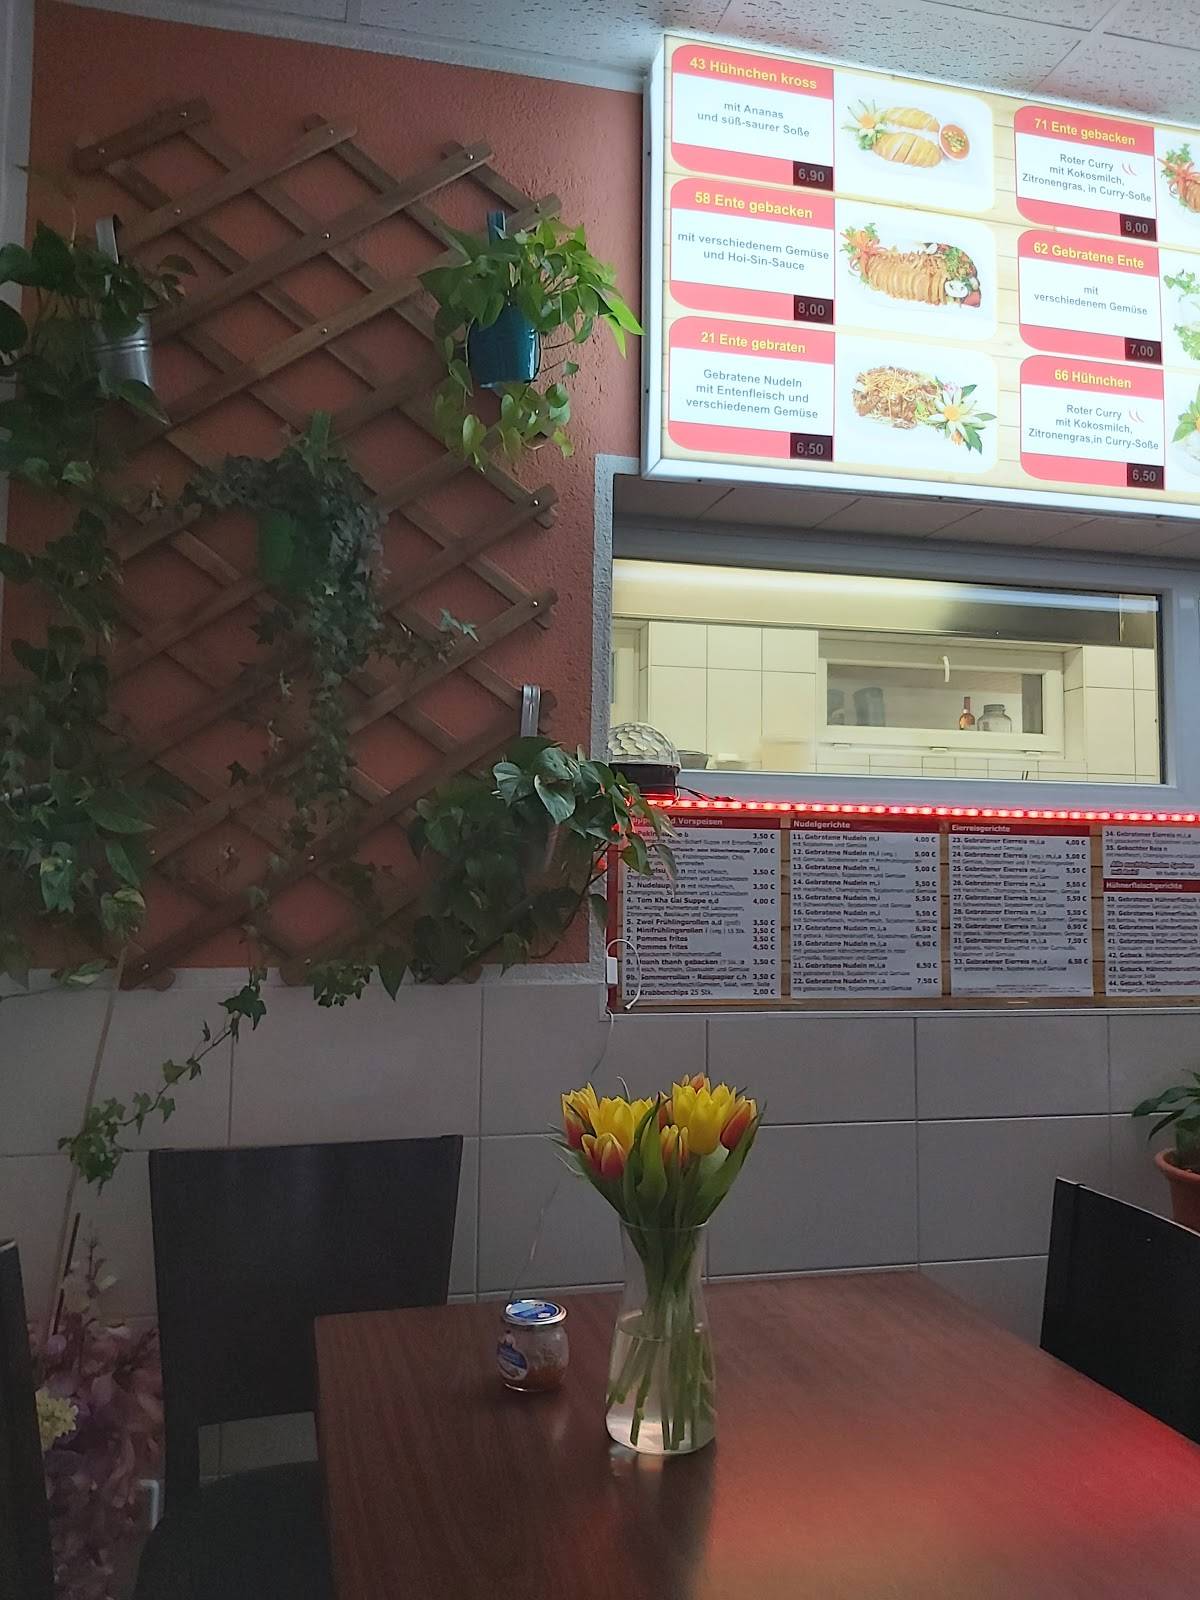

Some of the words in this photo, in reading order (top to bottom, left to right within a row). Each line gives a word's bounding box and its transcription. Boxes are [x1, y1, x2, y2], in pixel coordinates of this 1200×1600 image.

[689, 56, 706, 70] 43
[710, 60, 777, 83] Hühnchen
[781, 73, 817, 90] kross
[724, 101, 741, 112] mit
[743, 104, 784, 119] Ananas
[697, 112, 718, 123] und
[721, 115, 780, 133] süß-saurer
[783, 124, 811, 138] Soße
[1034, 118, 1047, 129] 71
[1051, 121, 1078, 136] Ente
[1080, 127, 1136, 146] gebacken
[1059, 154, 1086, 167] Roter
[1088, 158, 1114, 172] Curry
[798, 168, 825, 183] 6,90
[1049, 166, 1065, 176] mit
[1067, 168, 1125, 186] Kokosmilch,
[1022, 173, 1086, 193] Zitronengras,
[1088, 184, 1097, 194] in
[1099, 186, 1152, 203] Curry-Soße
[695, 192, 711, 204] 58
[714, 194, 745, 209] Ente
[749, 200, 813, 219] gebacken
[1125, 221, 1149, 235] 8,00
[677, 232, 695, 242] mit
[698, 234, 782, 253] verschiedenem
[785, 245, 830, 260] Gemüse
[1033, 242, 1048, 255] 62
[1051, 244, 1114, 265] Gebratene
[1117, 255, 1144, 269] Ente
[703, 249, 725, 261] und
[728, 251, 805, 271] Hoi-Sin-Sauce
[1083, 285, 1099, 295] mit
[798, 302, 825, 316] 8,00
[1033, 293, 1107, 310] verschiedenem
[1109, 302, 1148, 316] Gemüse
[700, 331, 715, 344] 21
[719, 333, 748, 348] Ente
[751, 338, 806, 354] gebraten
[1129, 343, 1154, 358] 7,00
[703, 368, 761, 384] Gebratene
[763, 375, 802, 388] Nudeln
[1054, 369, 1069, 382] 66
[1072, 370, 1132, 389] Hühnchen
[696, 384, 713, 394] mit
[717, 385, 785, 402] Entenfleisch
[788, 393, 809, 404] und
[686, 399, 770, 415] verschiedenem
[773, 405, 818, 419] Gemüse
[1066, 404, 1093, 417] Roter
[1095, 408, 1122, 421] Curry
[1055, 417, 1071, 428] mit
[1073, 418, 1133, 435] Kokosmilch,
[796, 442, 824, 456] 6,50
[1105, 436, 1159, 450] Curry-Soße
[1132, 469, 1156, 483] 6,50
[678, 818, 723, 826] Vorspeisen
[793, 820, 851, 829] Nudelgerichte
[951, 824, 1010, 832] Eierreisgerichte
